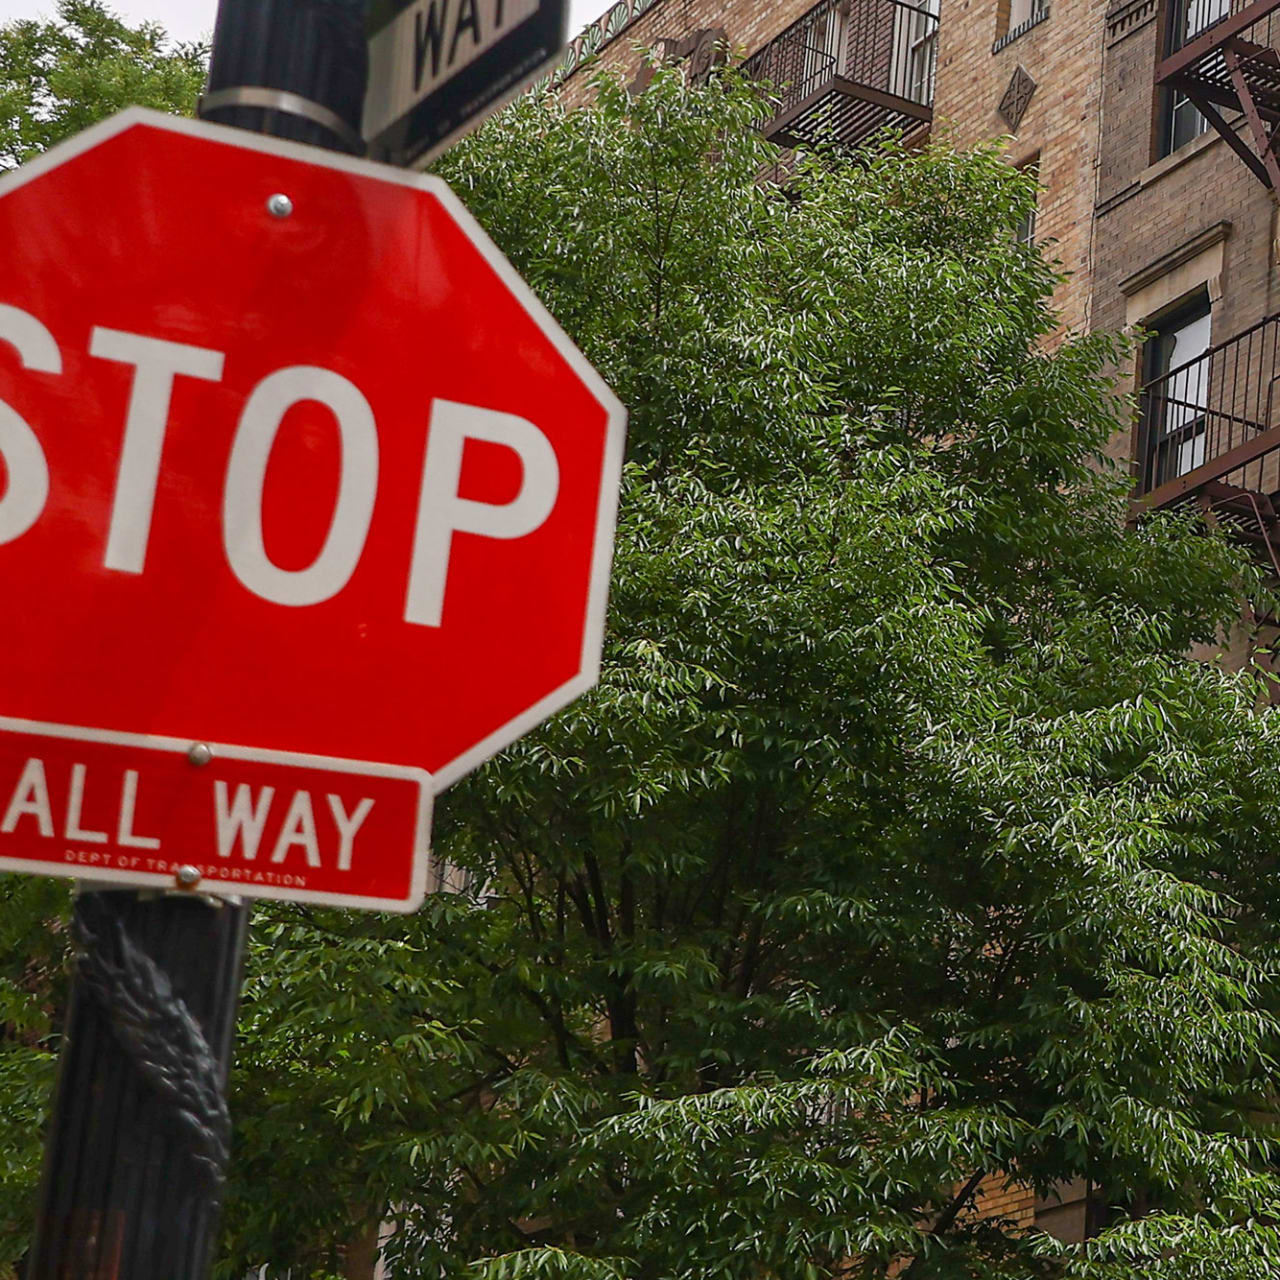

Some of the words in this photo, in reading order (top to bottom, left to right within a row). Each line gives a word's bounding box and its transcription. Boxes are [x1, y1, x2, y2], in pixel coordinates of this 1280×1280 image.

[1, 757, 161, 850] ALL
[213, 779, 376, 871] WAY
[65, 849, 112, 867] DEPT
[117, 855, 139, 868] OF
[147, 858, 307, 888] TRASPORTATION
